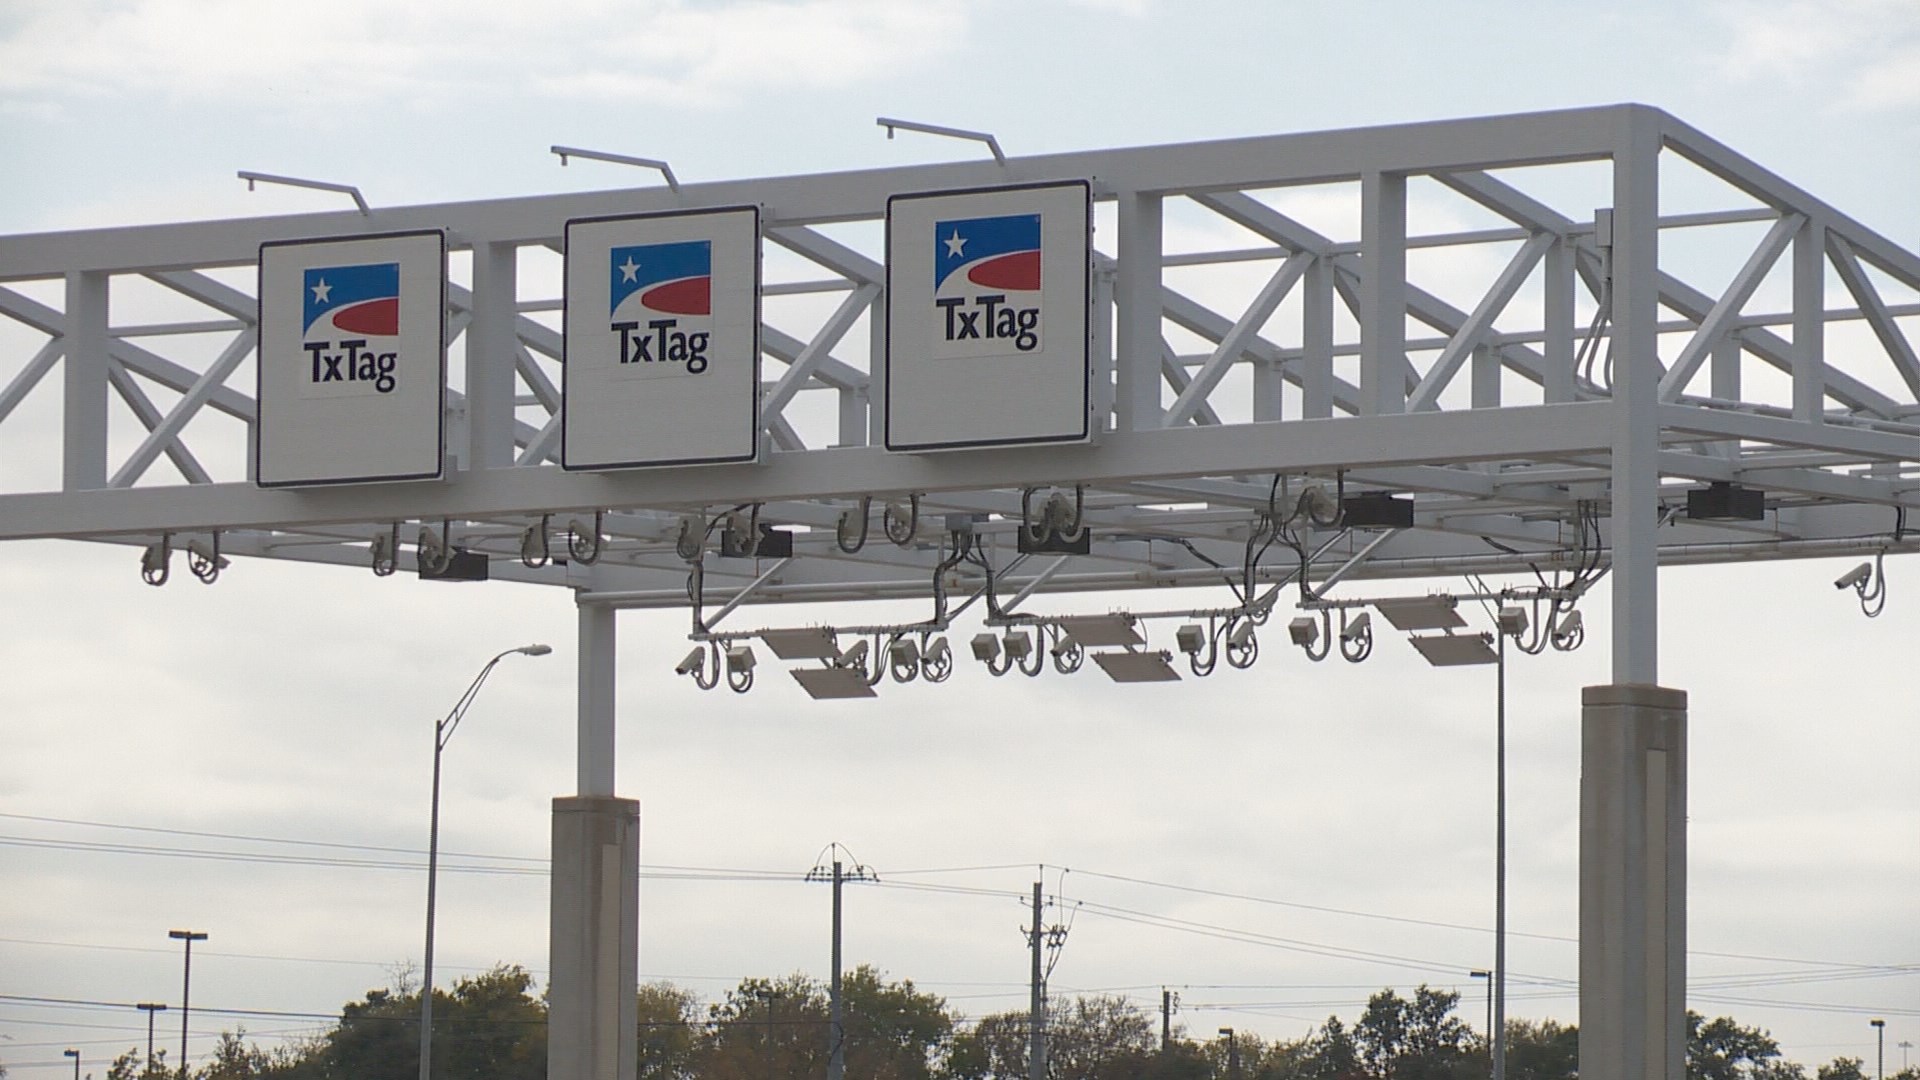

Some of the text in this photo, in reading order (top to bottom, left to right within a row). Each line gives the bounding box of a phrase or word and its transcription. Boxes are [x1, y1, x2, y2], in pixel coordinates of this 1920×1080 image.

[611, 320, 709, 374] TxTag
[936, 296, 1039, 351] TxTag
[303, 340, 398, 393] TxTag
